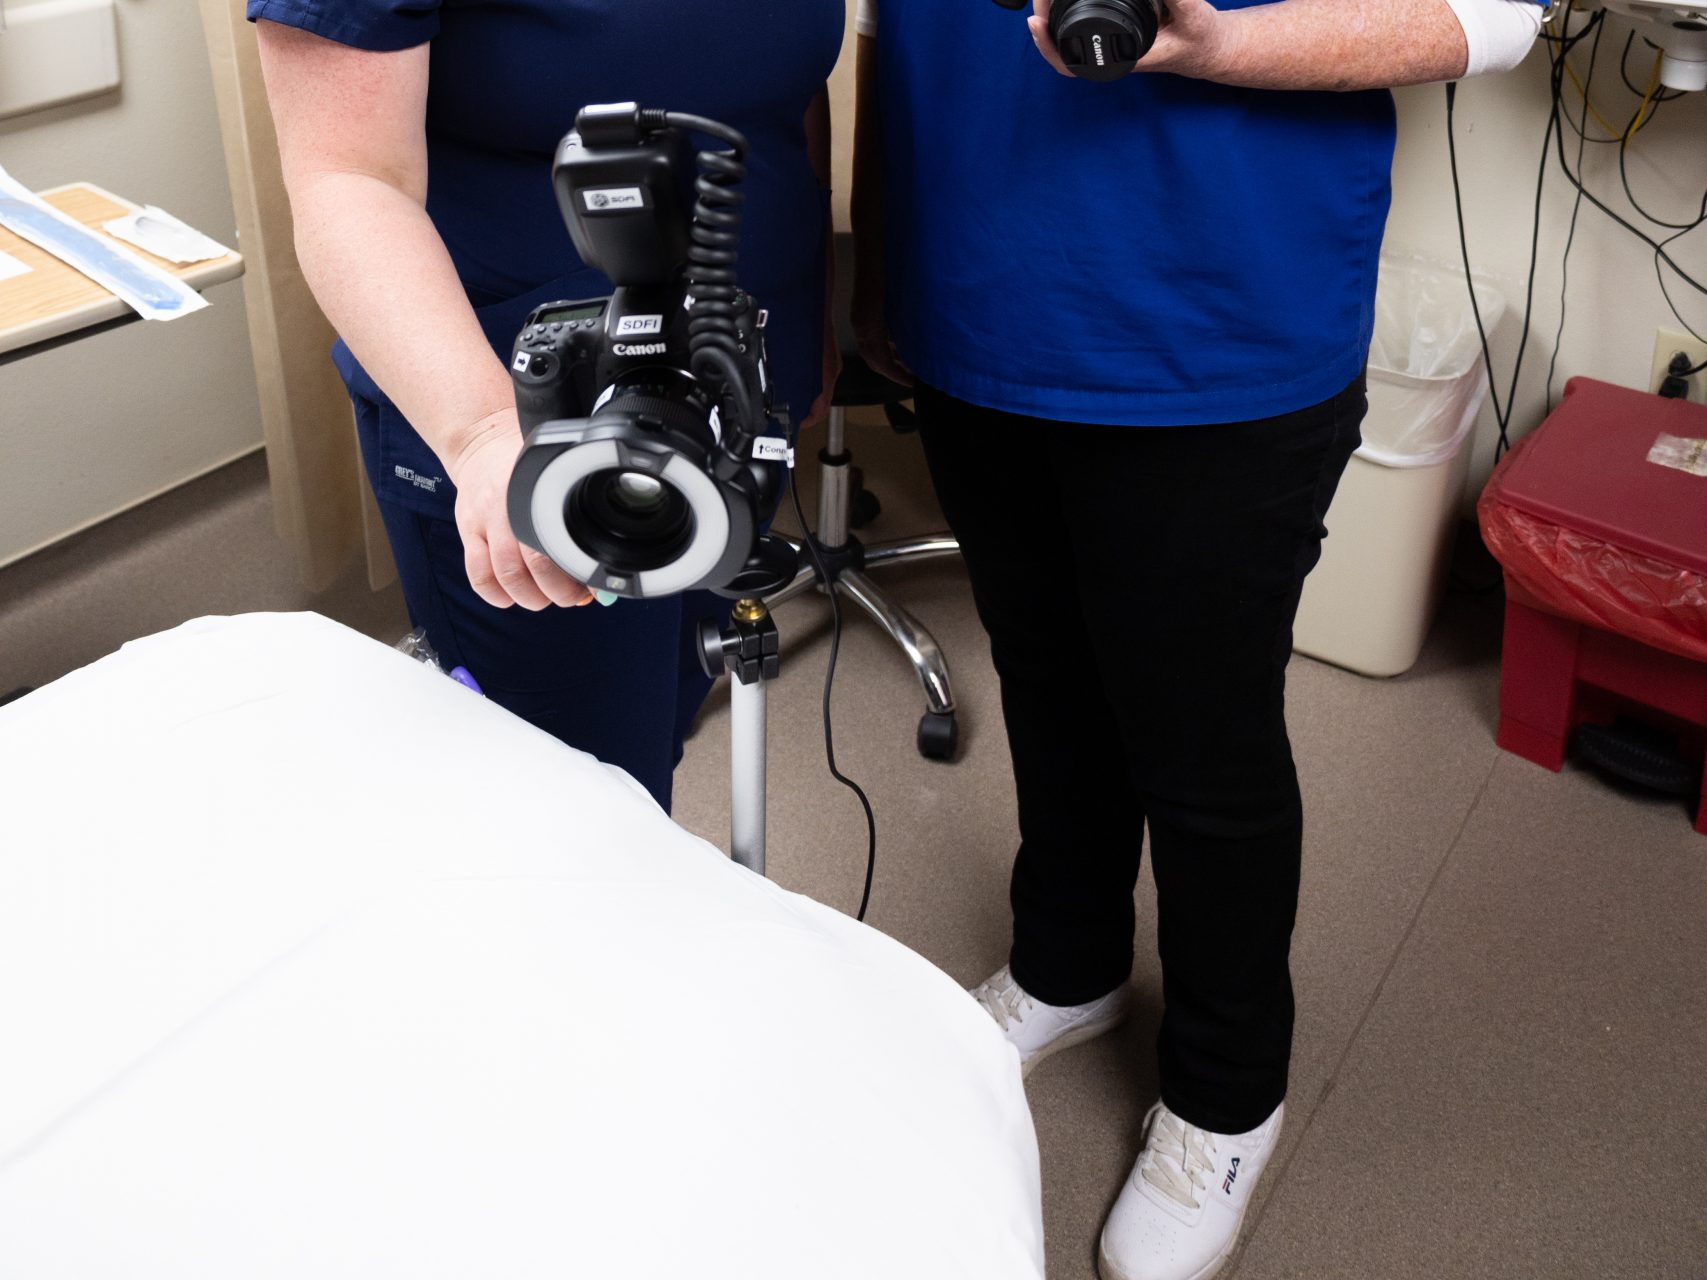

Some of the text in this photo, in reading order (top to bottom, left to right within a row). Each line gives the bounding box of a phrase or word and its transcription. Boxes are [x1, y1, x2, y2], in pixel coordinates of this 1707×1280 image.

[1092, 34, 1105, 66] Canon
[622, 319, 658, 330] SDFI
[612, 342, 667, 356] Canon
[1222, 1157, 1240, 1195] FILA
